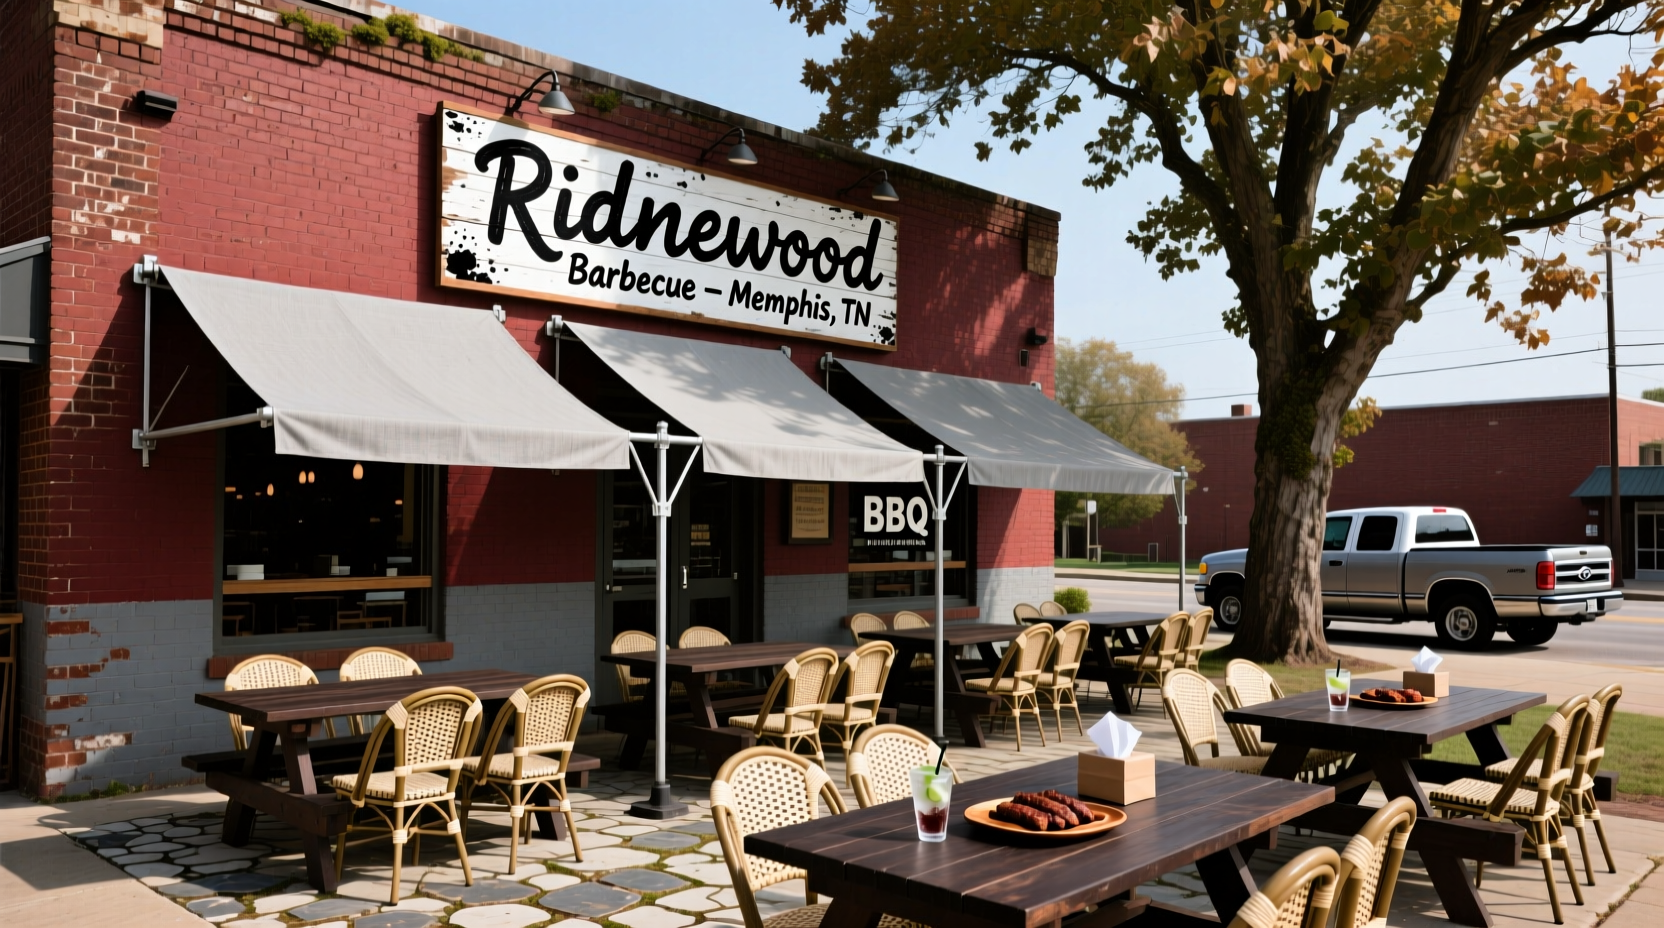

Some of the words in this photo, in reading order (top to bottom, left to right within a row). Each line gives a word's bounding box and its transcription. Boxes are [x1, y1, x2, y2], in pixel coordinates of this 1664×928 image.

[475, 138, 884, 291] Ridnewood
[567, 252, 696, 300] Barbecue
[728, 279, 836, 326] Memphis,
[841, 298, 872, 327] TN
[864, 495, 928, 537] BBQ
